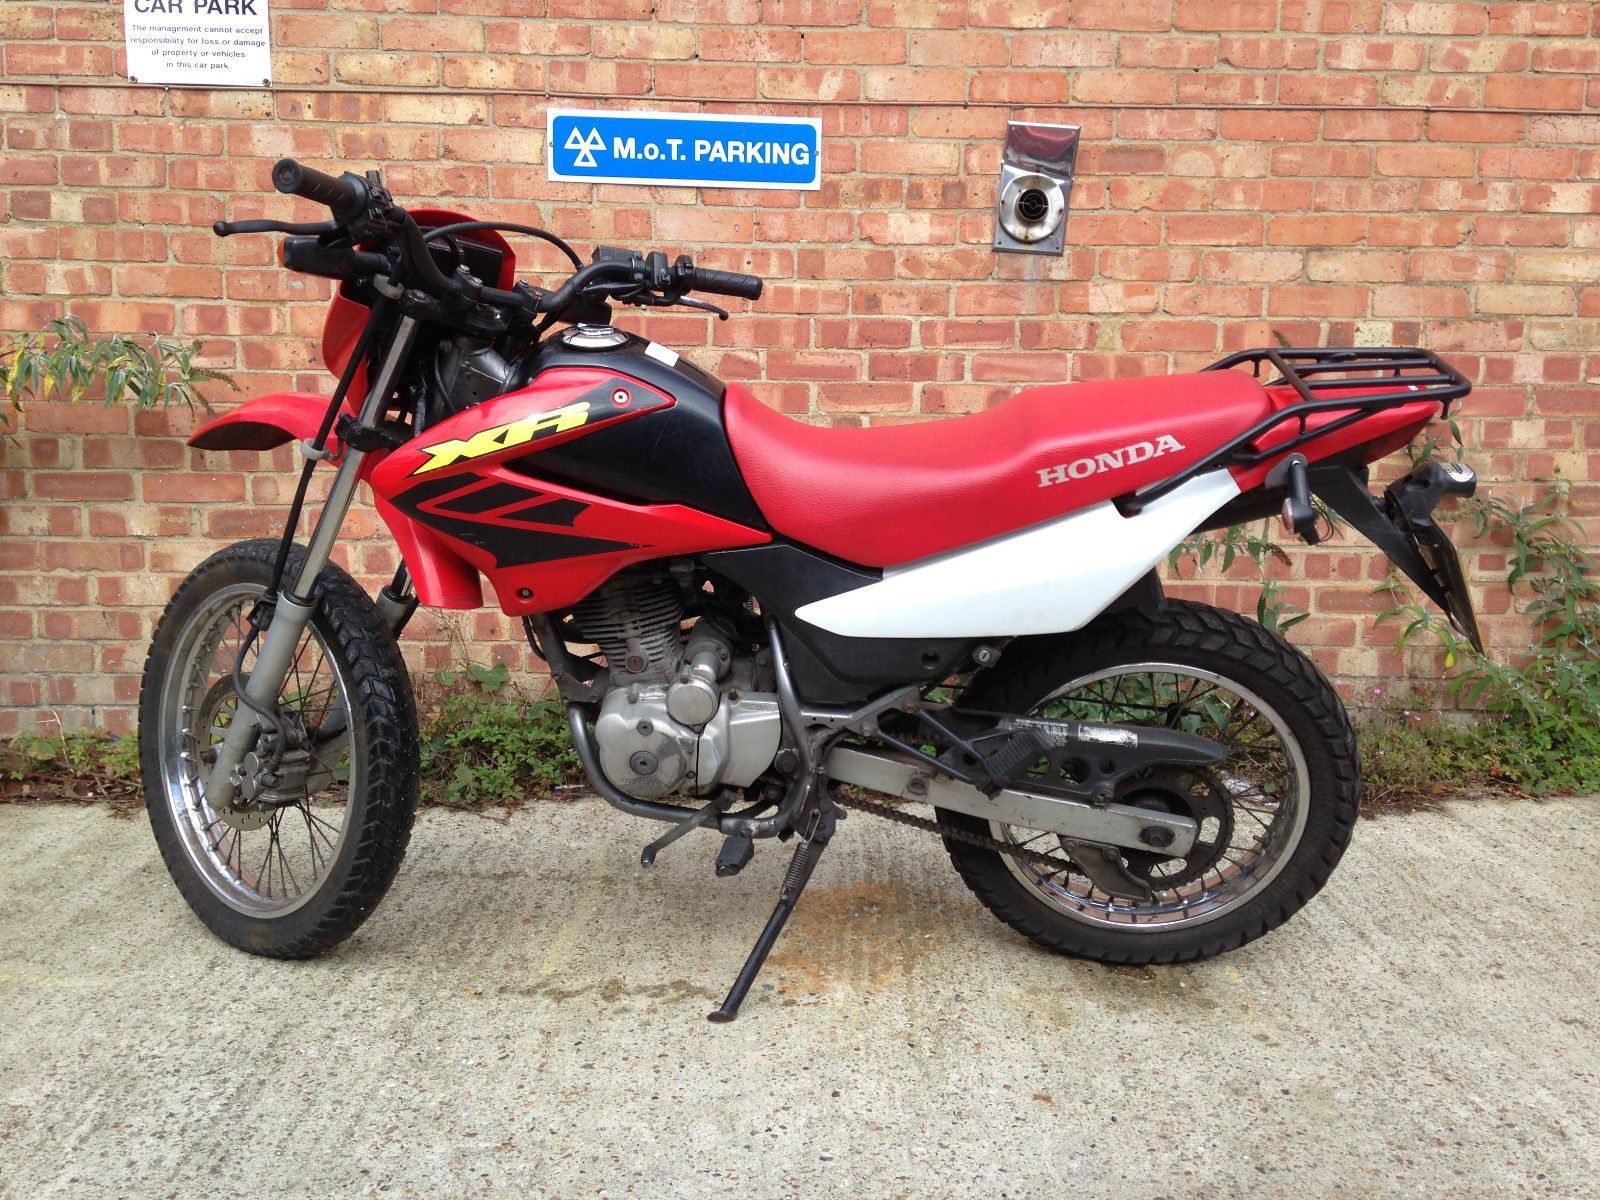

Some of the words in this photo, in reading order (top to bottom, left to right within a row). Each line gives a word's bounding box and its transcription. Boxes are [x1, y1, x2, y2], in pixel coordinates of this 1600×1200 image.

[134, 0, 183, 13] CAR
[194, 0, 258, 15] PARK
[149, 26, 202, 35] management
[235, 27, 263, 35] accept
[130, 37, 184, 45] responsibility
[233, 39, 266, 47] damage
[613, 137, 686, 161] M.o.T.
[694, 140, 810, 166] PARKING
[1036, 434, 1186, 488] HONDA
